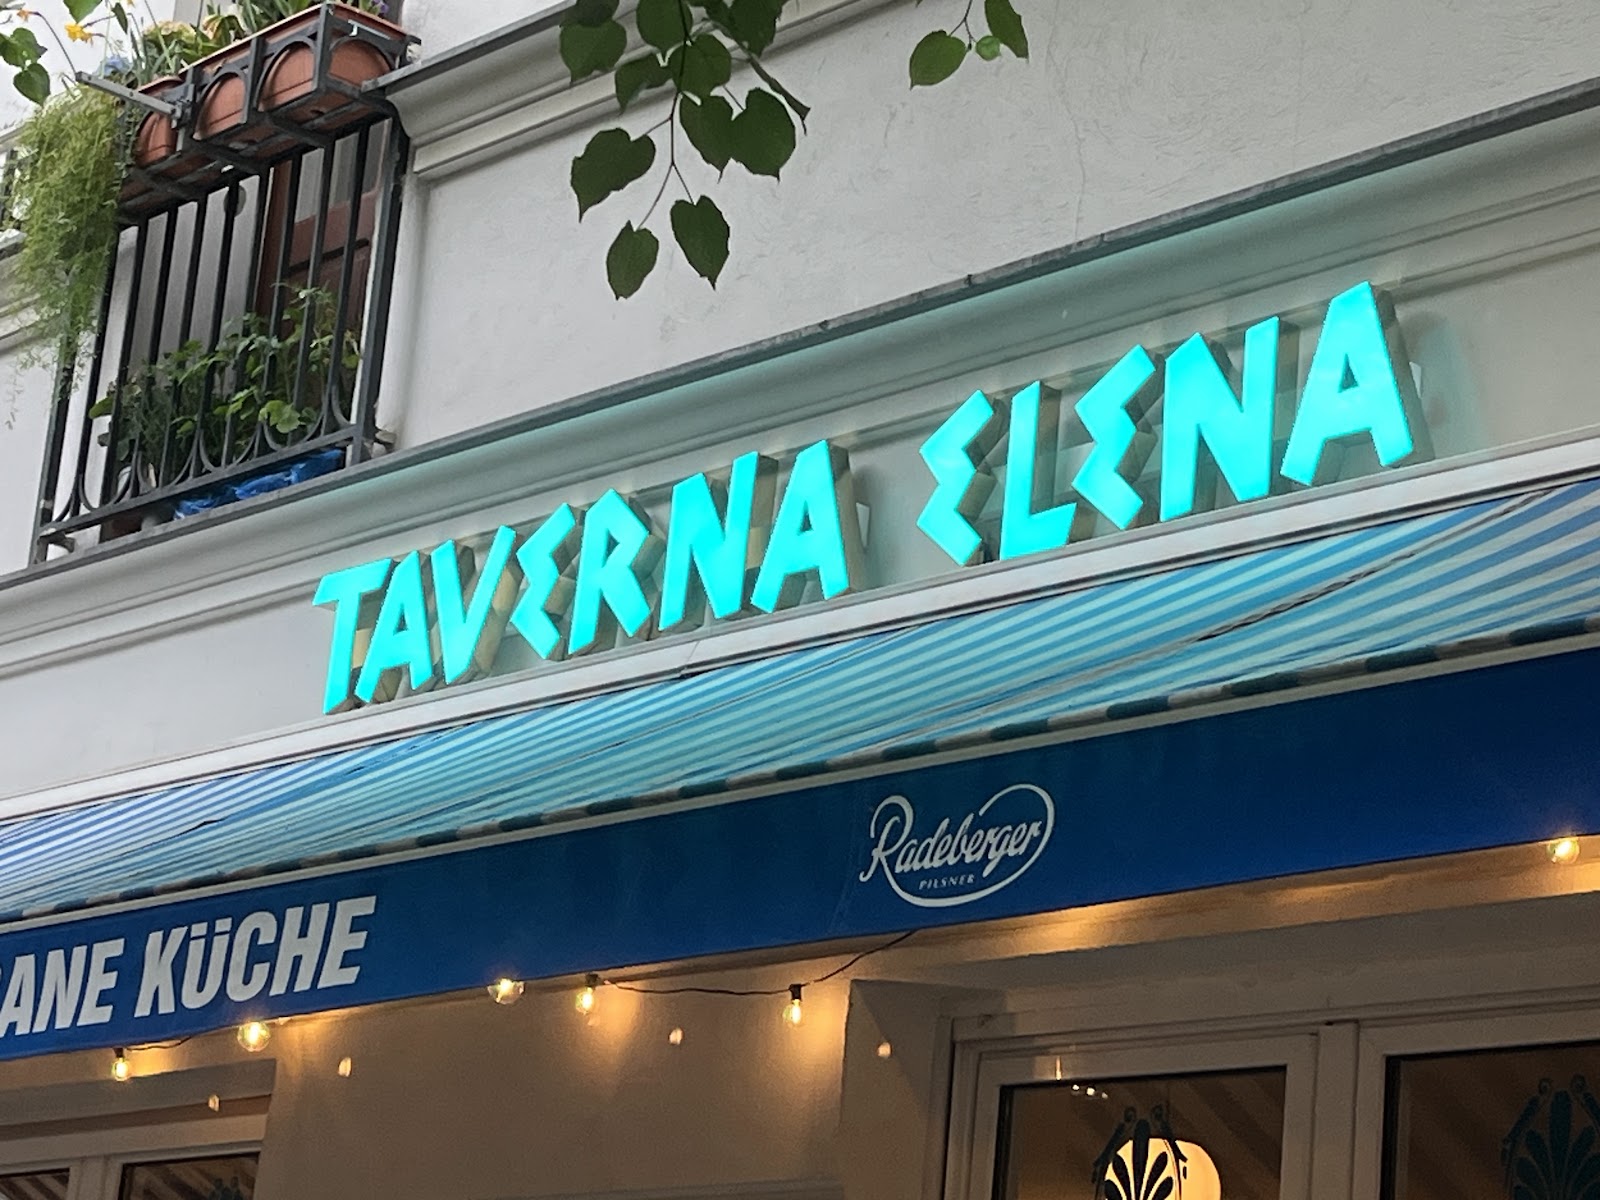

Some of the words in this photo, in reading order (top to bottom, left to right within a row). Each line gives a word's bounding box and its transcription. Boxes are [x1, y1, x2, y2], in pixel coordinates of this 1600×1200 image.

[312, 439, 850, 715] TAVERNA
[916, 280, 1414, 567] ELENA
[859, 783, 1055, 907] Radeberger
[918, 874, 976, 890] PILSNER
[0, 938, 125, 1038] ANE
